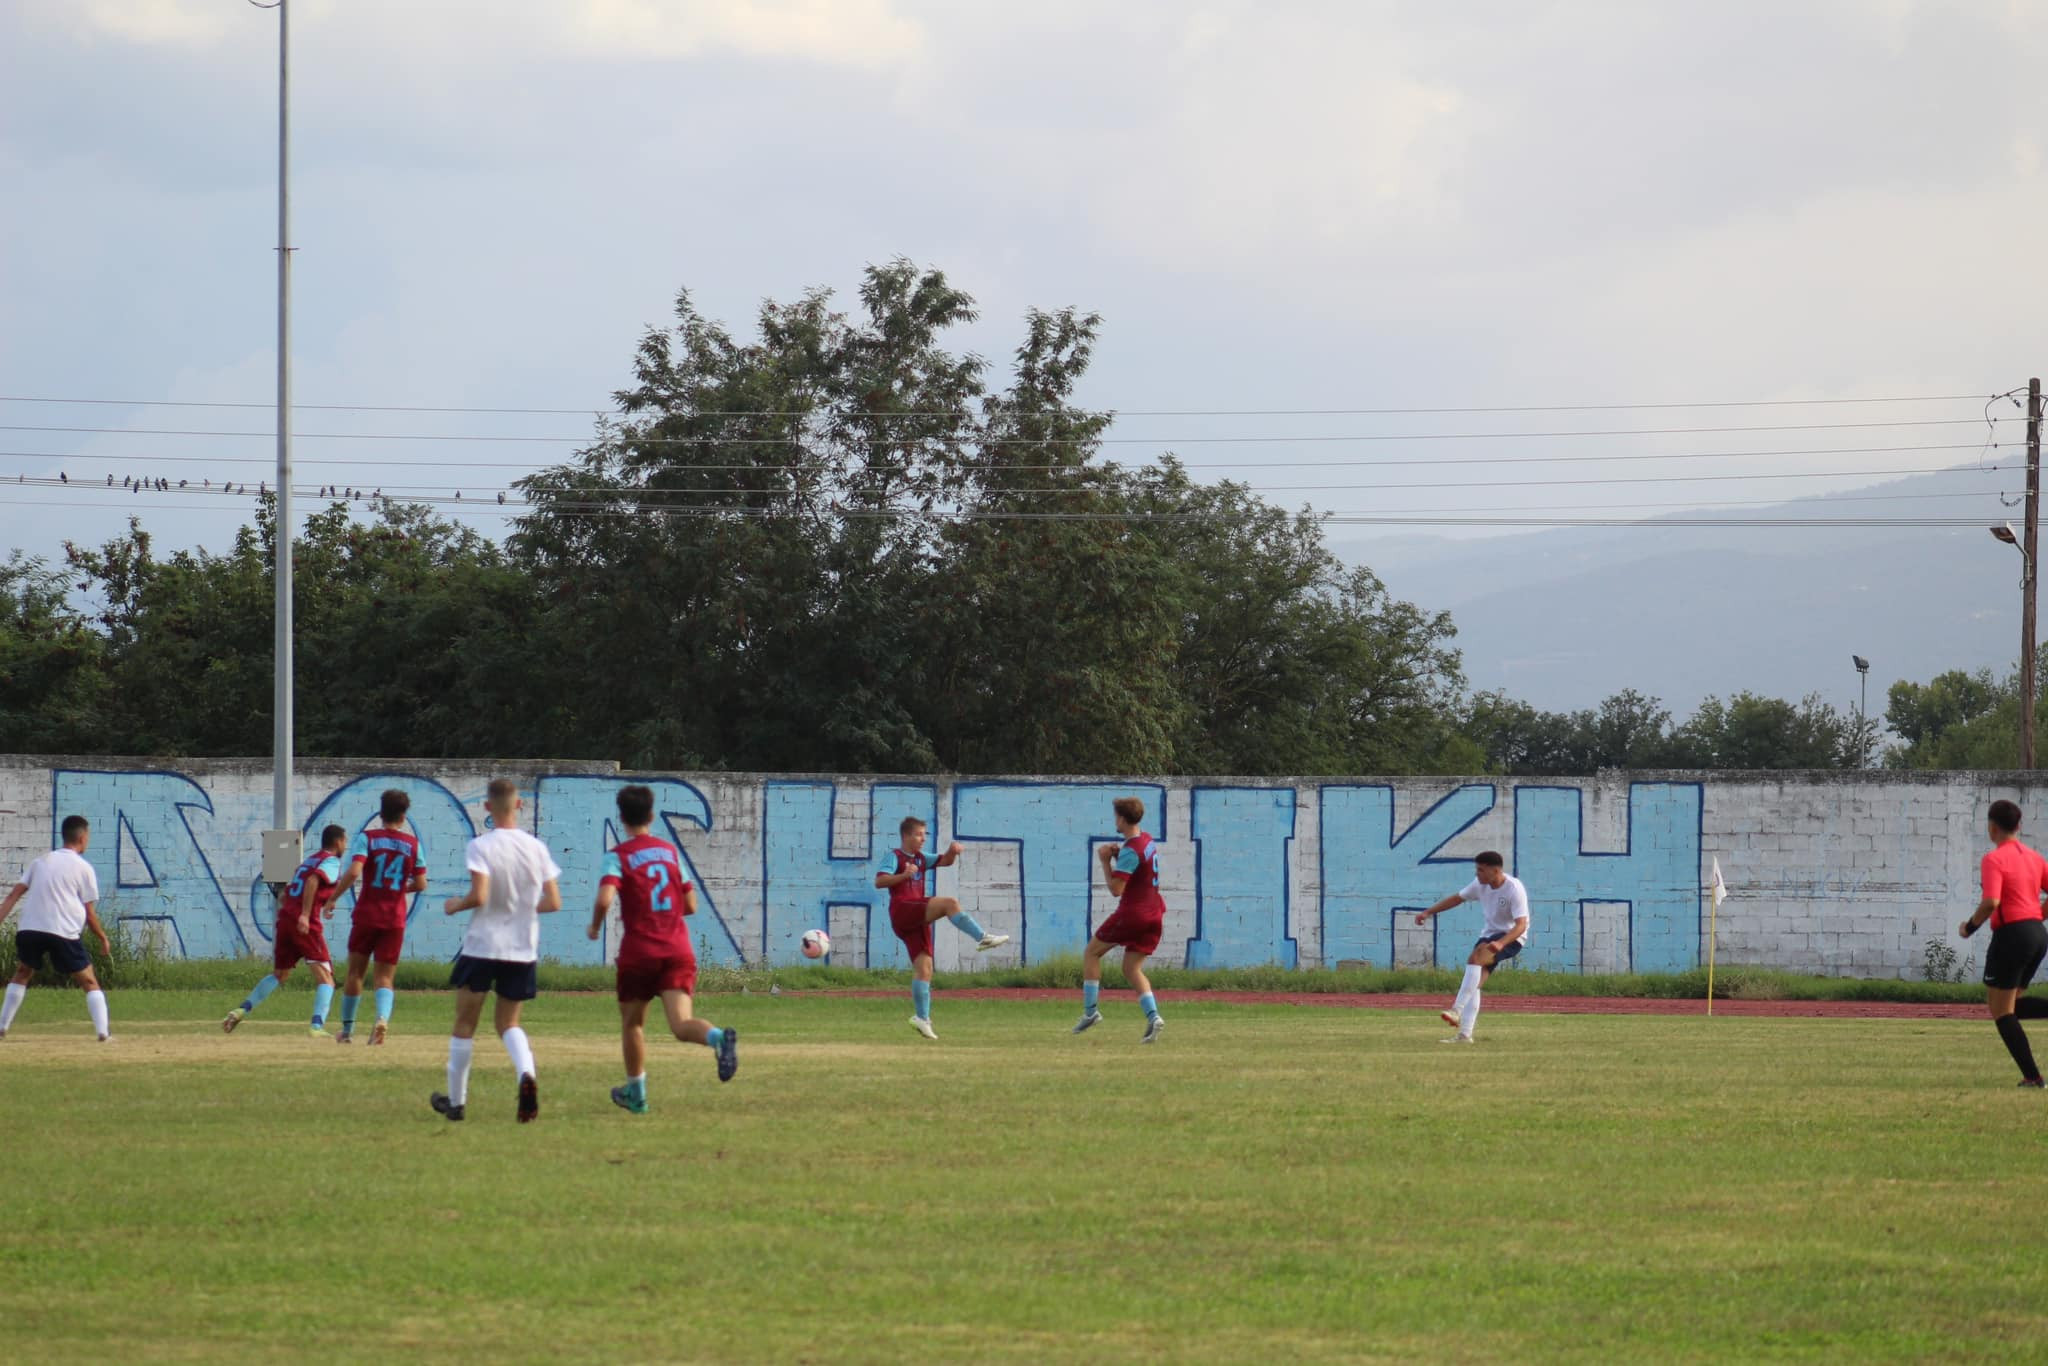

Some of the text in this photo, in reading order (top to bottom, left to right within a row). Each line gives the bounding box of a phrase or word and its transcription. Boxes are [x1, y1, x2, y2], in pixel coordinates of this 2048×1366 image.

[288, 865, 308, 897] 5
[371, 852, 405, 890] 14
[647, 863, 672, 912] 2
